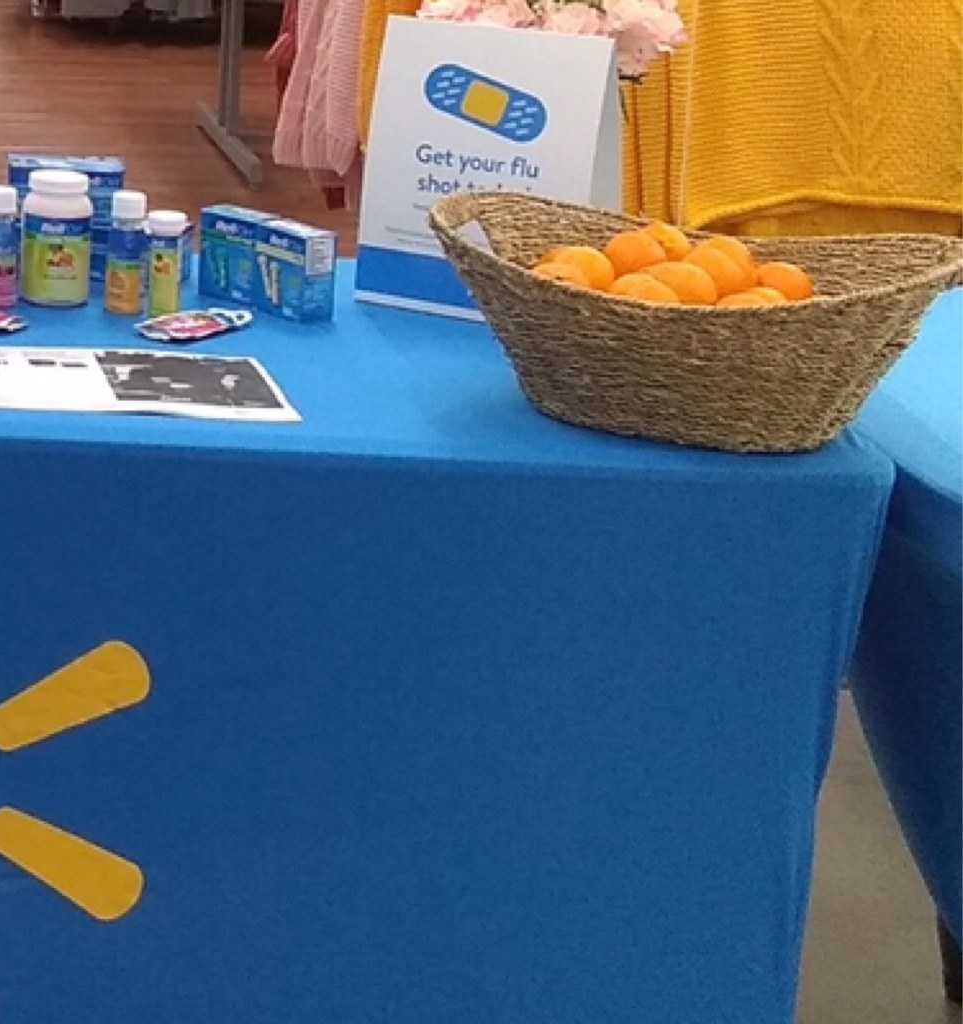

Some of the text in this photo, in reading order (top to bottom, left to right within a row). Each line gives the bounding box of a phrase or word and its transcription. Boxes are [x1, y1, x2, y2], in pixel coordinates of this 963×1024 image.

[415, 142, 540, 179] Get your flu
[417, 173, 460, 194] shot
